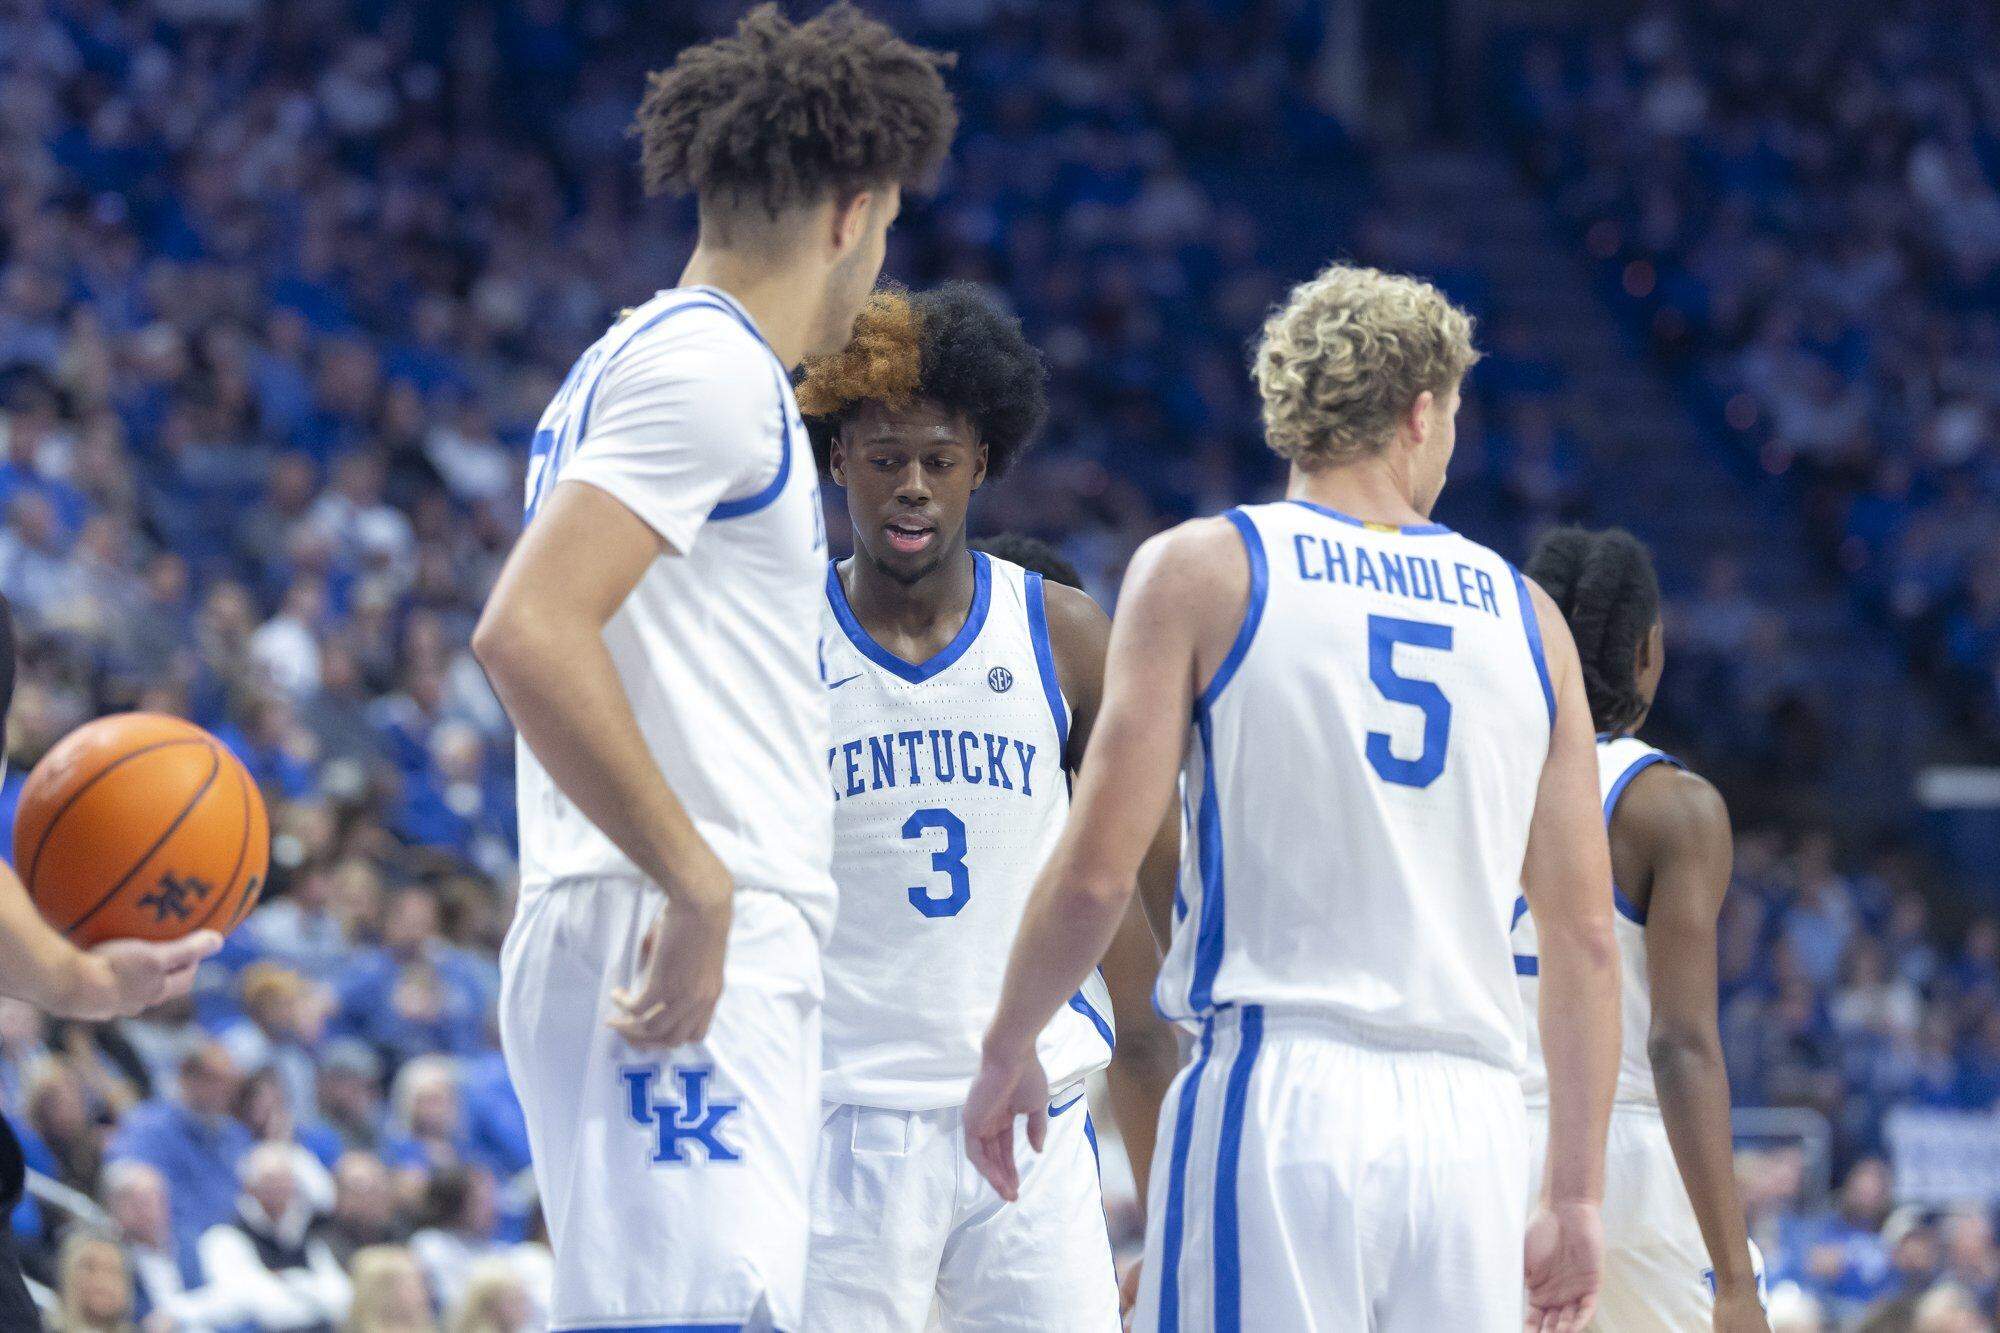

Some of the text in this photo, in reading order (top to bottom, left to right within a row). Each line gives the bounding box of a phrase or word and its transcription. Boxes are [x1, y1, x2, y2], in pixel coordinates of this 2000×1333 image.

[1293, 534, 1501, 618] CHANDLER
[989, 667, 1013, 692] SEC
[1365, 613, 1454, 789] 5
[902, 808, 971, 918] 3
[621, 1066, 741, 1163] UK
